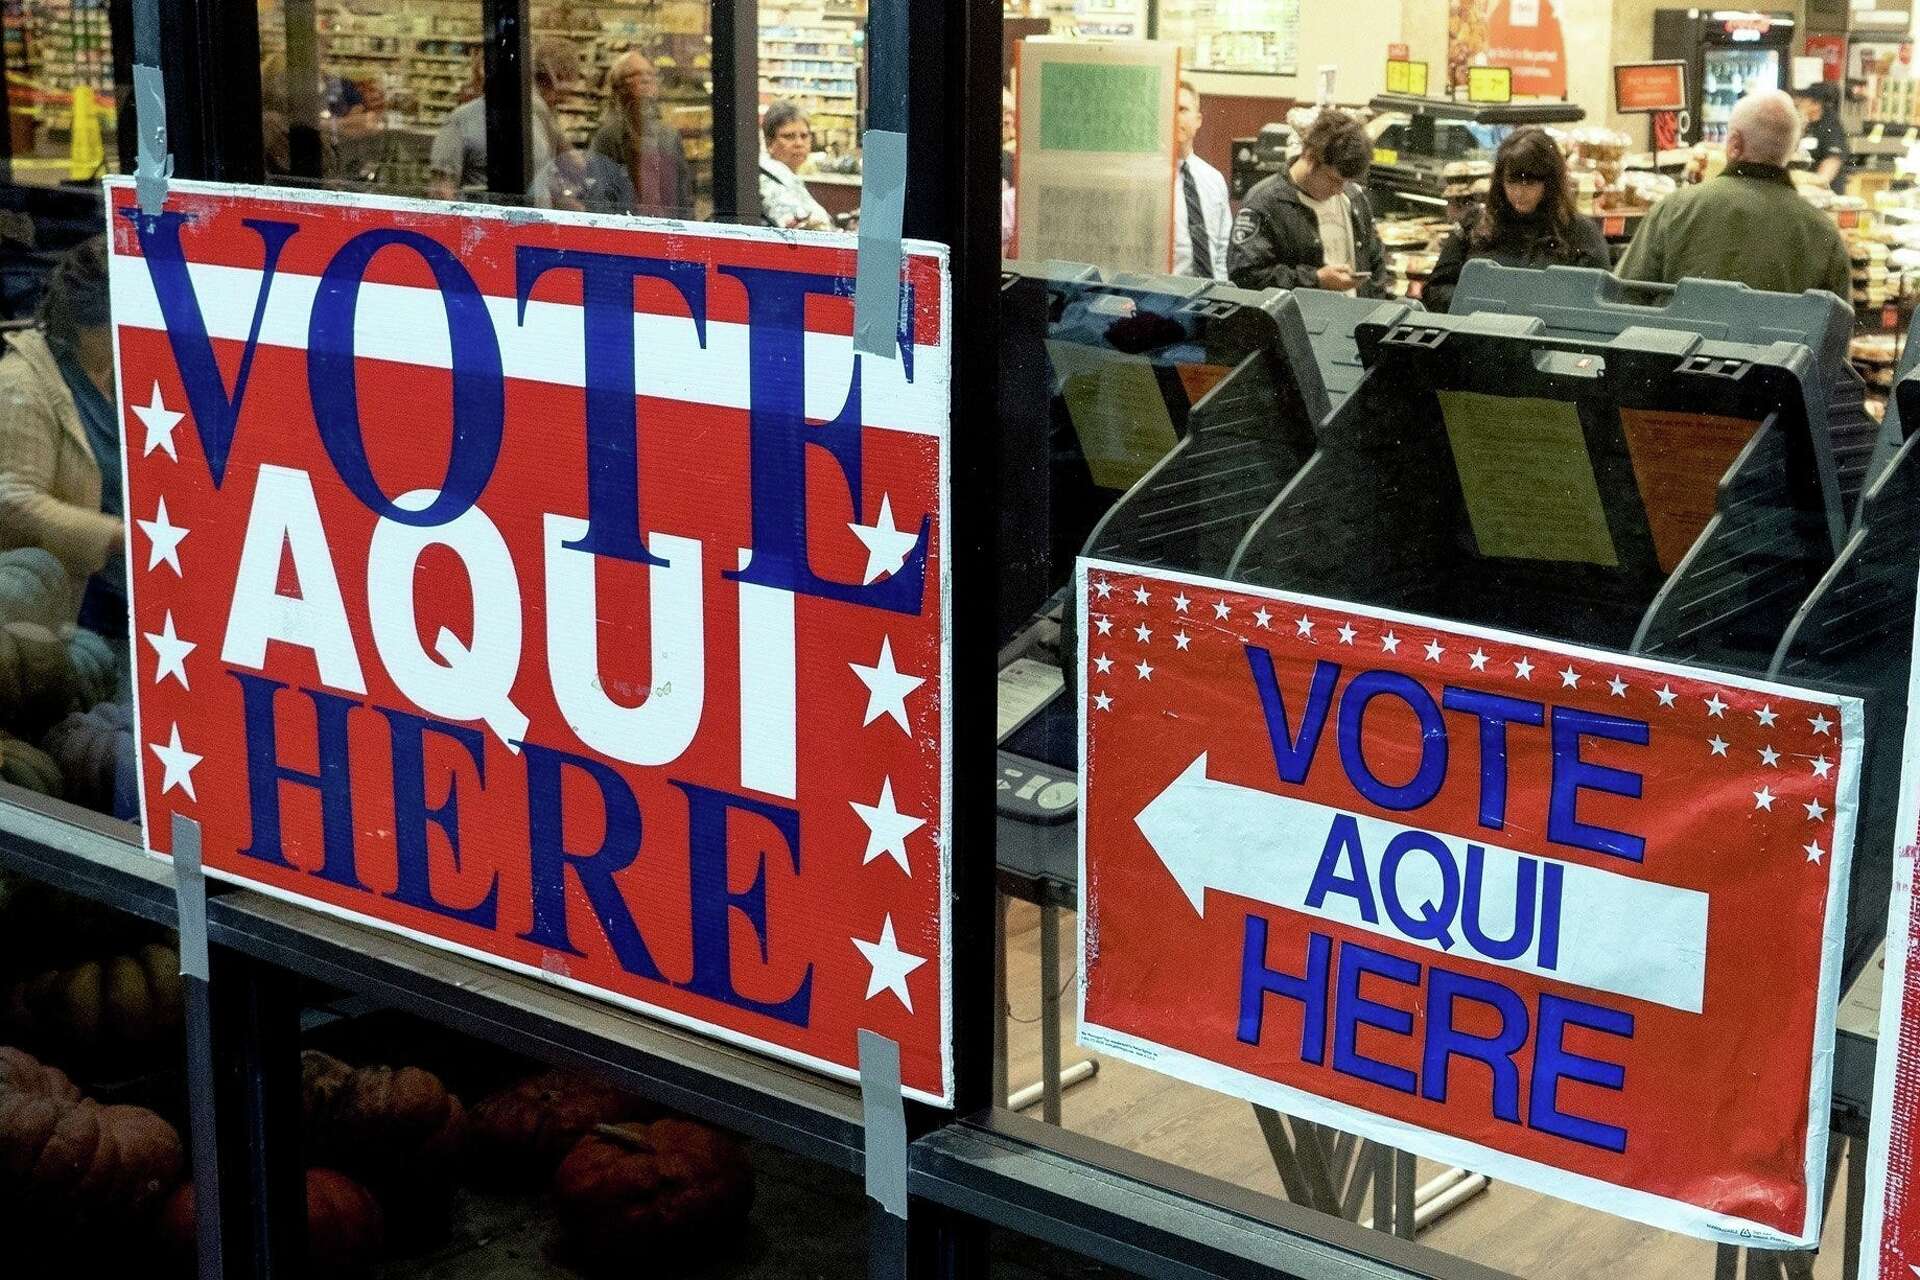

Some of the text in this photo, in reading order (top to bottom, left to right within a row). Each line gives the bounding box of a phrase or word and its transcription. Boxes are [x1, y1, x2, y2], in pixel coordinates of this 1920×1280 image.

[118, 206, 931, 616] VOTE
[220, 463, 798, 800] AQUI
[1244, 645, 1650, 864] VOTE
[224, 670, 814, 1029] HERE
[1303, 812, 1565, 972] AQUI
[1236, 913, 1635, 1154] HERE
